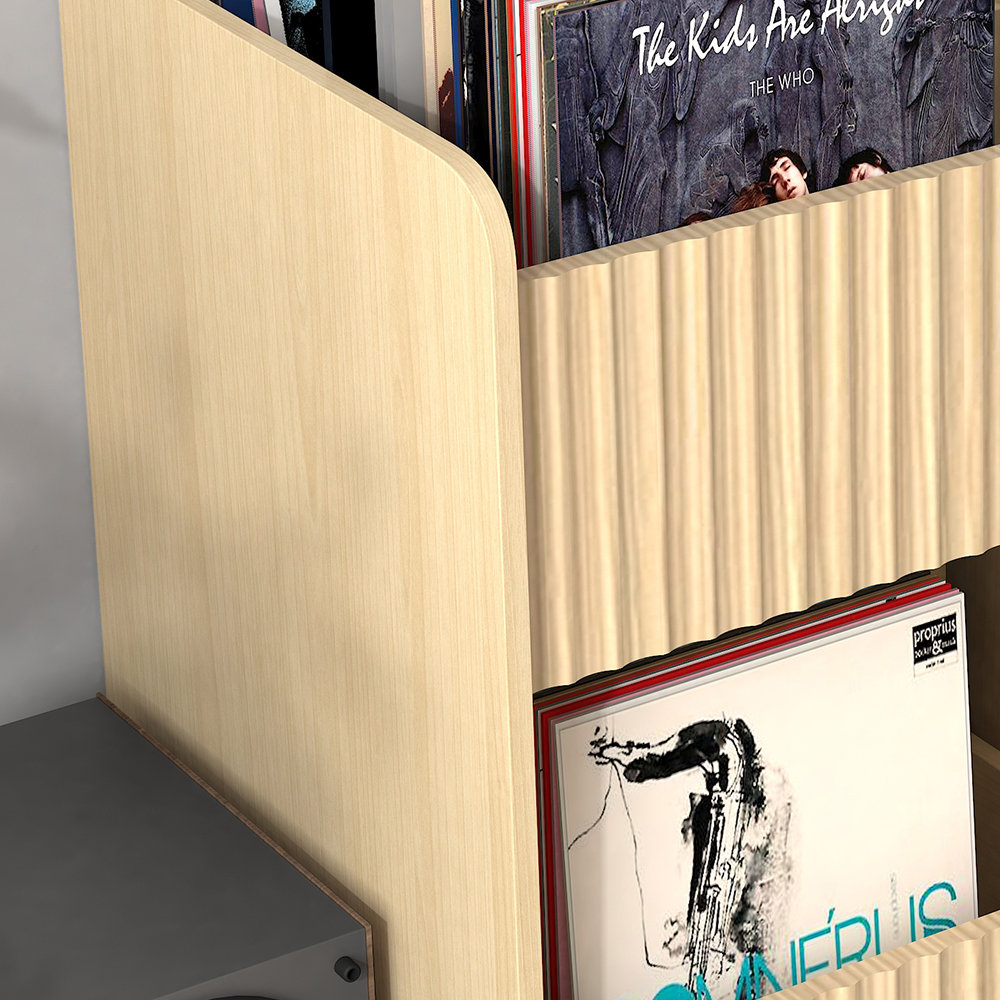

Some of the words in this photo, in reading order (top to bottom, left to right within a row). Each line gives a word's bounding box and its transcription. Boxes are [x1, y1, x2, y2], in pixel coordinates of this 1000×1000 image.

[632, 21, 679, 76] The
[688, 3, 758, 63] Kids
[749, 76, 774, 98] THE
[778, 67, 815, 91] WHO
[913, 617, 956, 648] proprius
